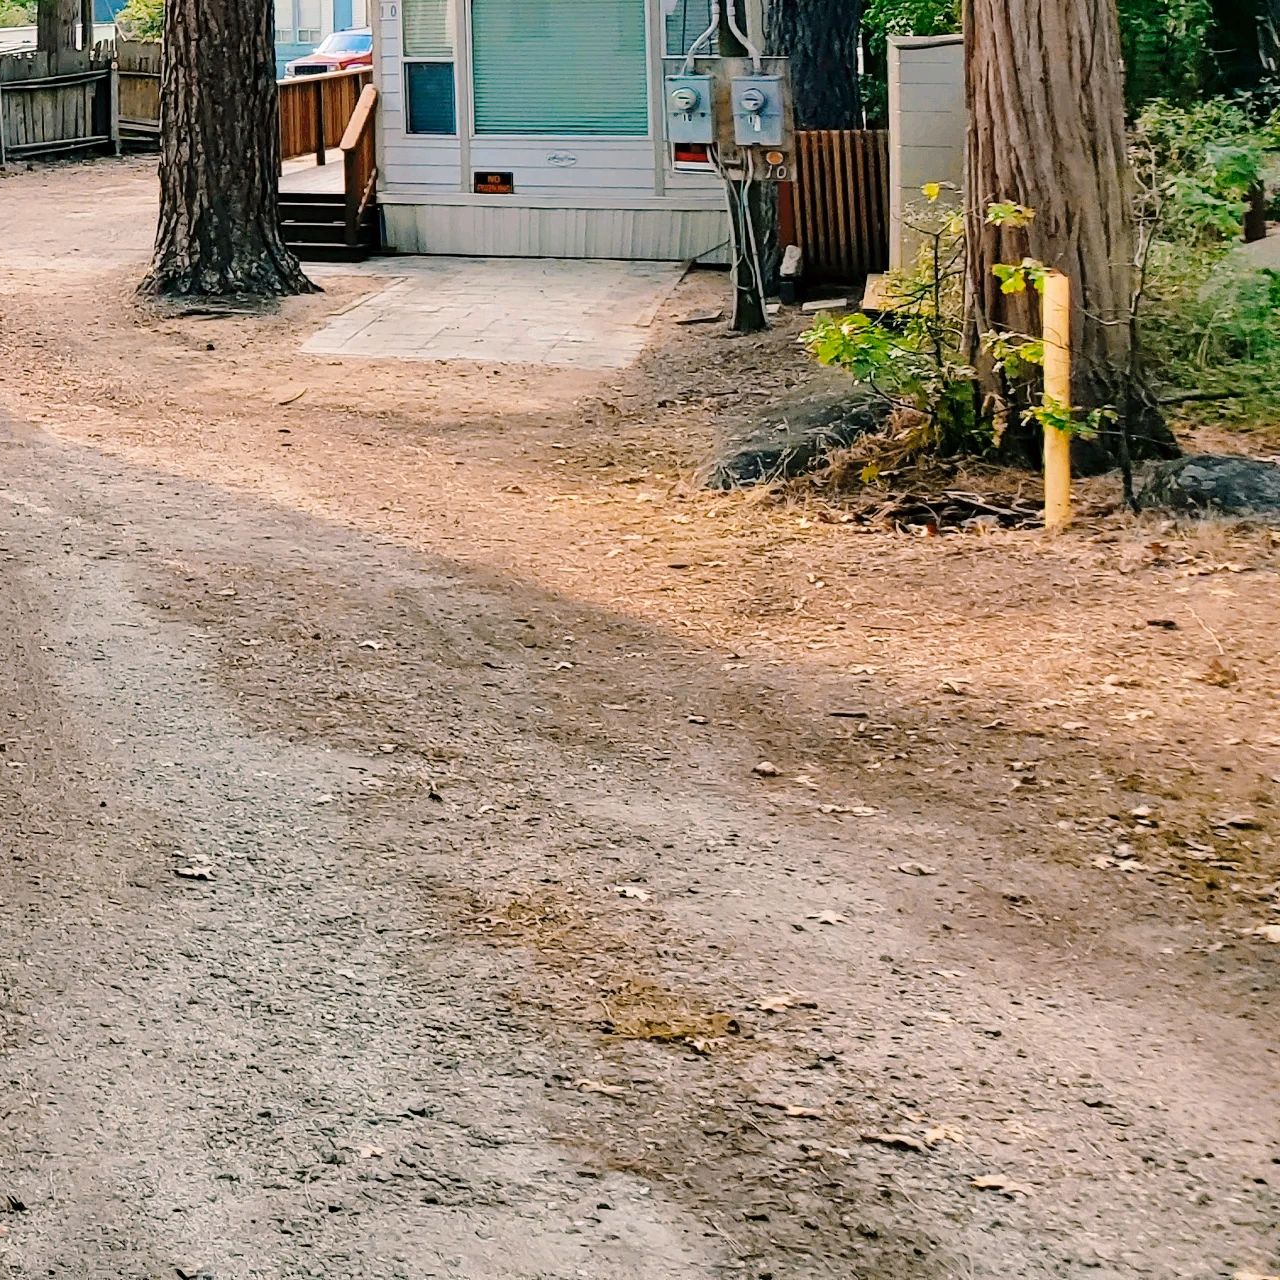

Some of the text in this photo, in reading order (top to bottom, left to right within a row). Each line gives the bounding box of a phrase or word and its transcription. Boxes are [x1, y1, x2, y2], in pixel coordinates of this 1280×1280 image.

[381, 5, 397, 17] 10
[765, 164, 787, 179] 10
[487, 175, 500, 183] NO
